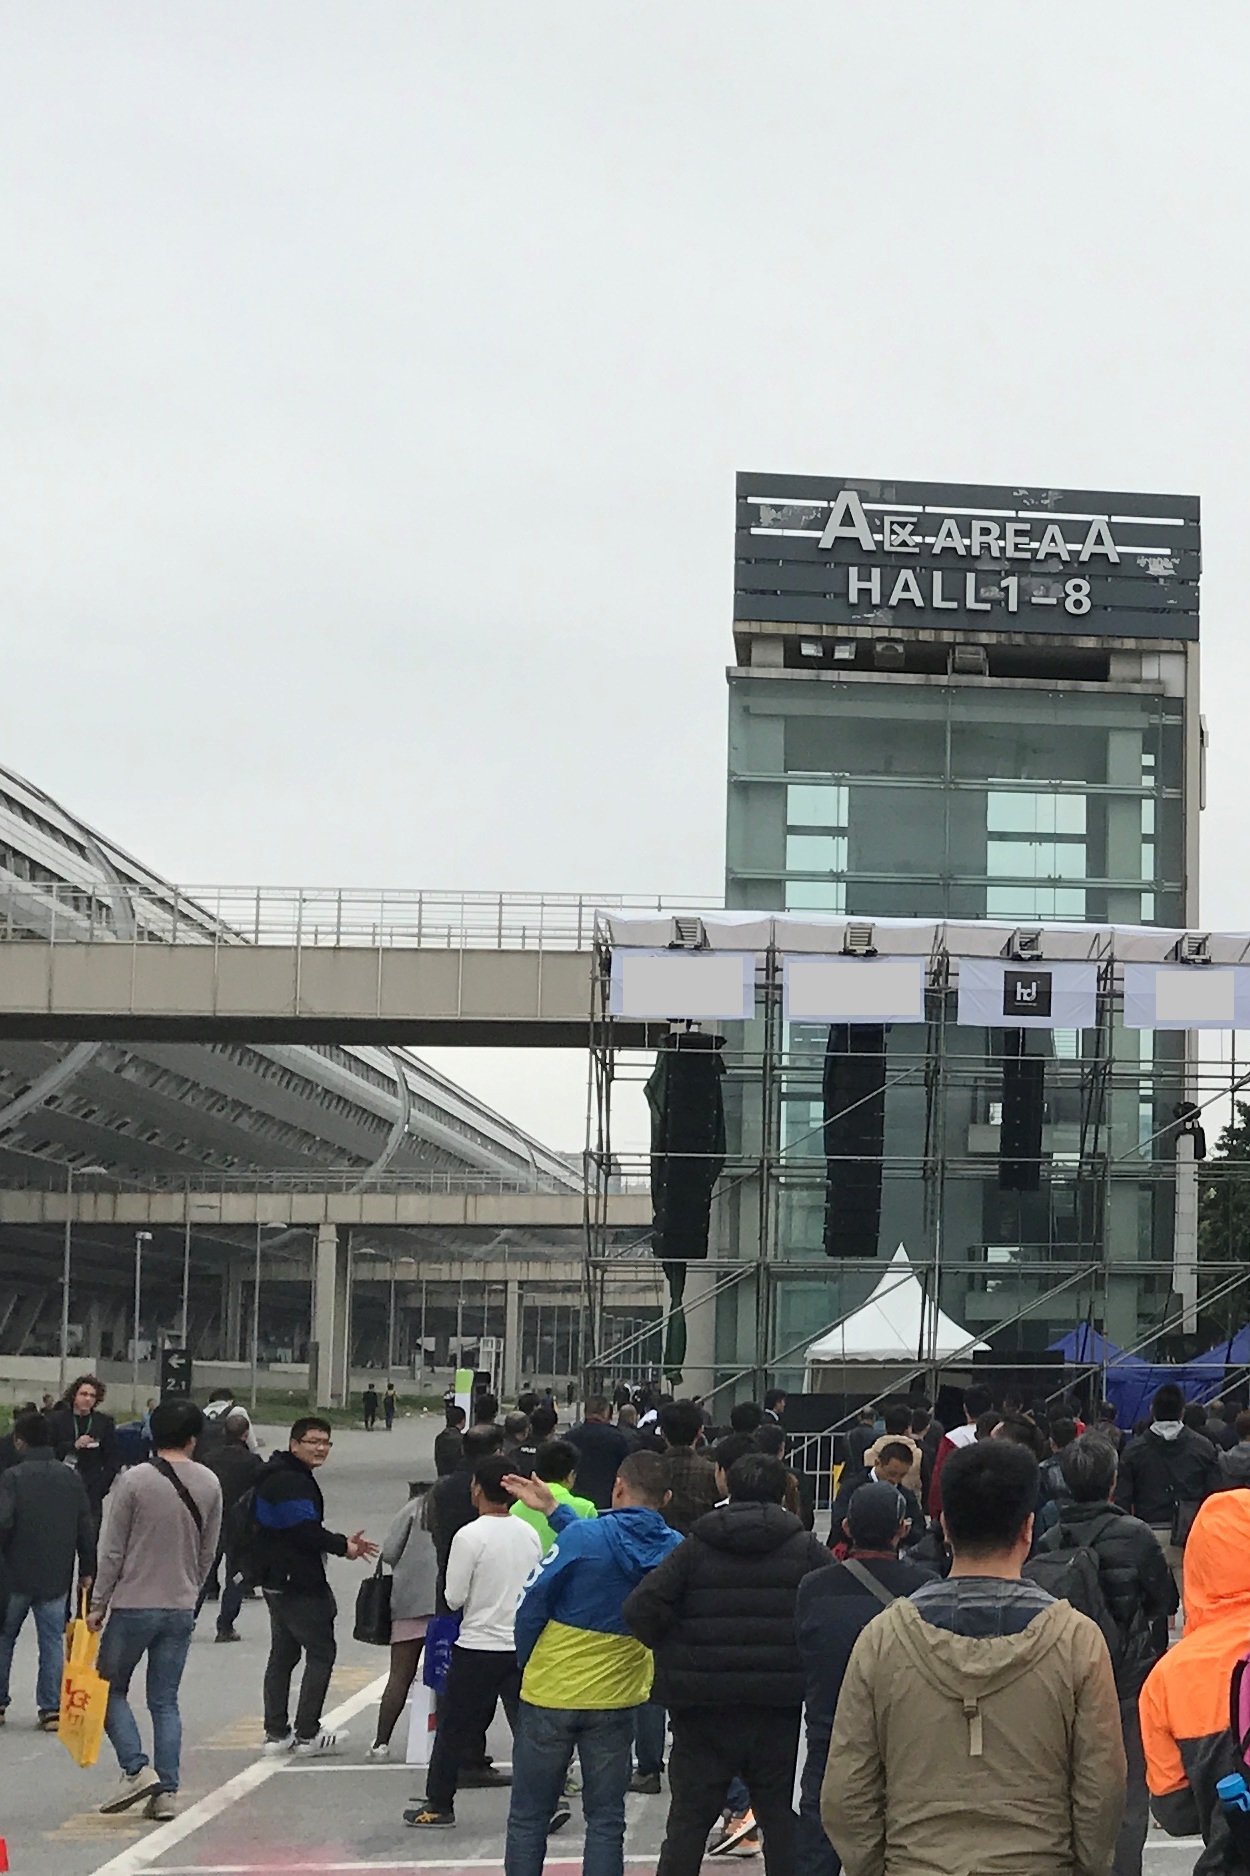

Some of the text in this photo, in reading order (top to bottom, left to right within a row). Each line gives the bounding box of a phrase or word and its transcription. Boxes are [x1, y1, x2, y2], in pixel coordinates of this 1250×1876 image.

[931, 518, 1071, 562] AREA
[1078, 518, 1121, 563] A
[847, 566, 992, 611] HALL
